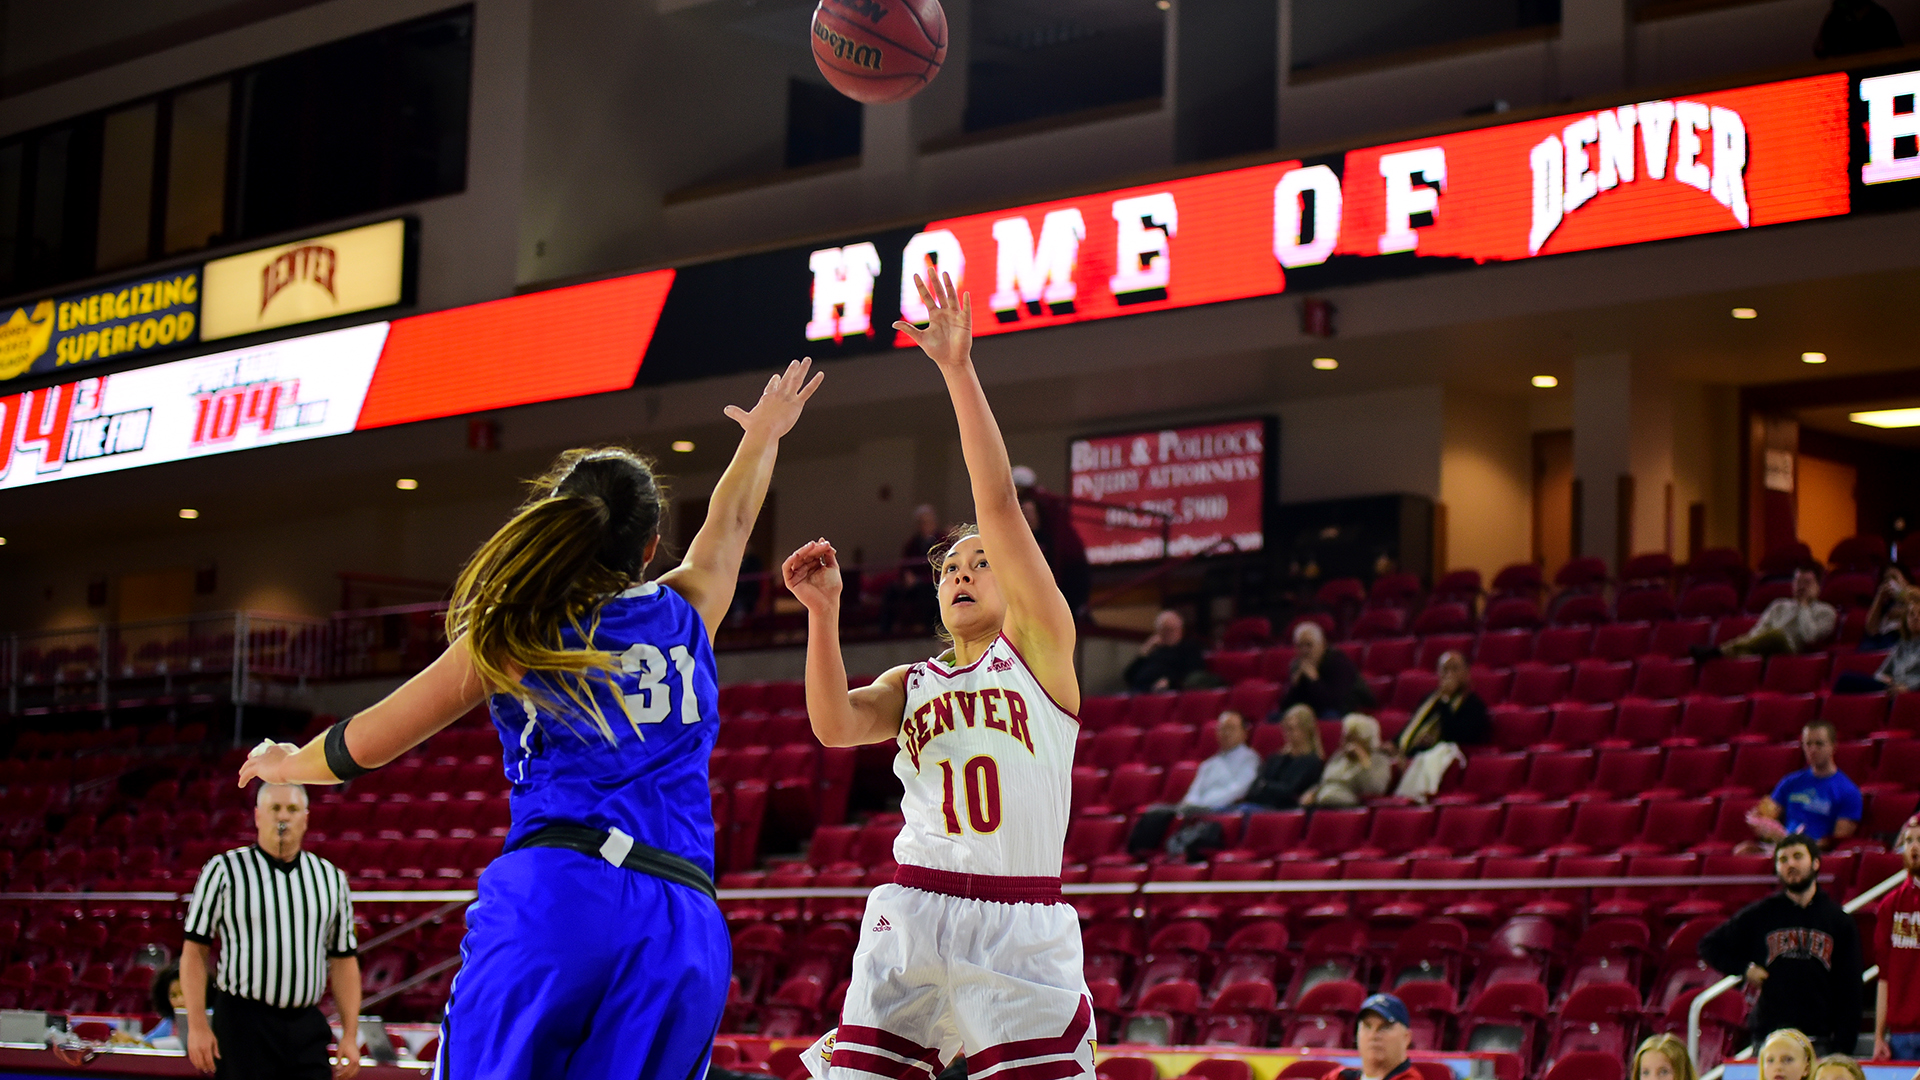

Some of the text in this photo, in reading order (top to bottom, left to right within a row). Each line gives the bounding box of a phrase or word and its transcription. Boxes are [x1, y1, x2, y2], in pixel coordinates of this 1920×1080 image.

[813, 19, 883, 71] Wilson
[1528, 99, 1750, 257] DENVER
[806, 146, 1447, 342] HOME OF
[58, 273, 198, 332] ENERGIZING
[260, 245, 339, 320] DENVER
[56, 311, 196, 367] SUPERFOOD
[1158, 429, 1264, 463] POLLOCK
[618, 642, 702, 725] 31
[903, 687, 1036, 779] DENVER
[935, 753, 1003, 836] 10
[1765, 927, 1834, 972] DENVER
